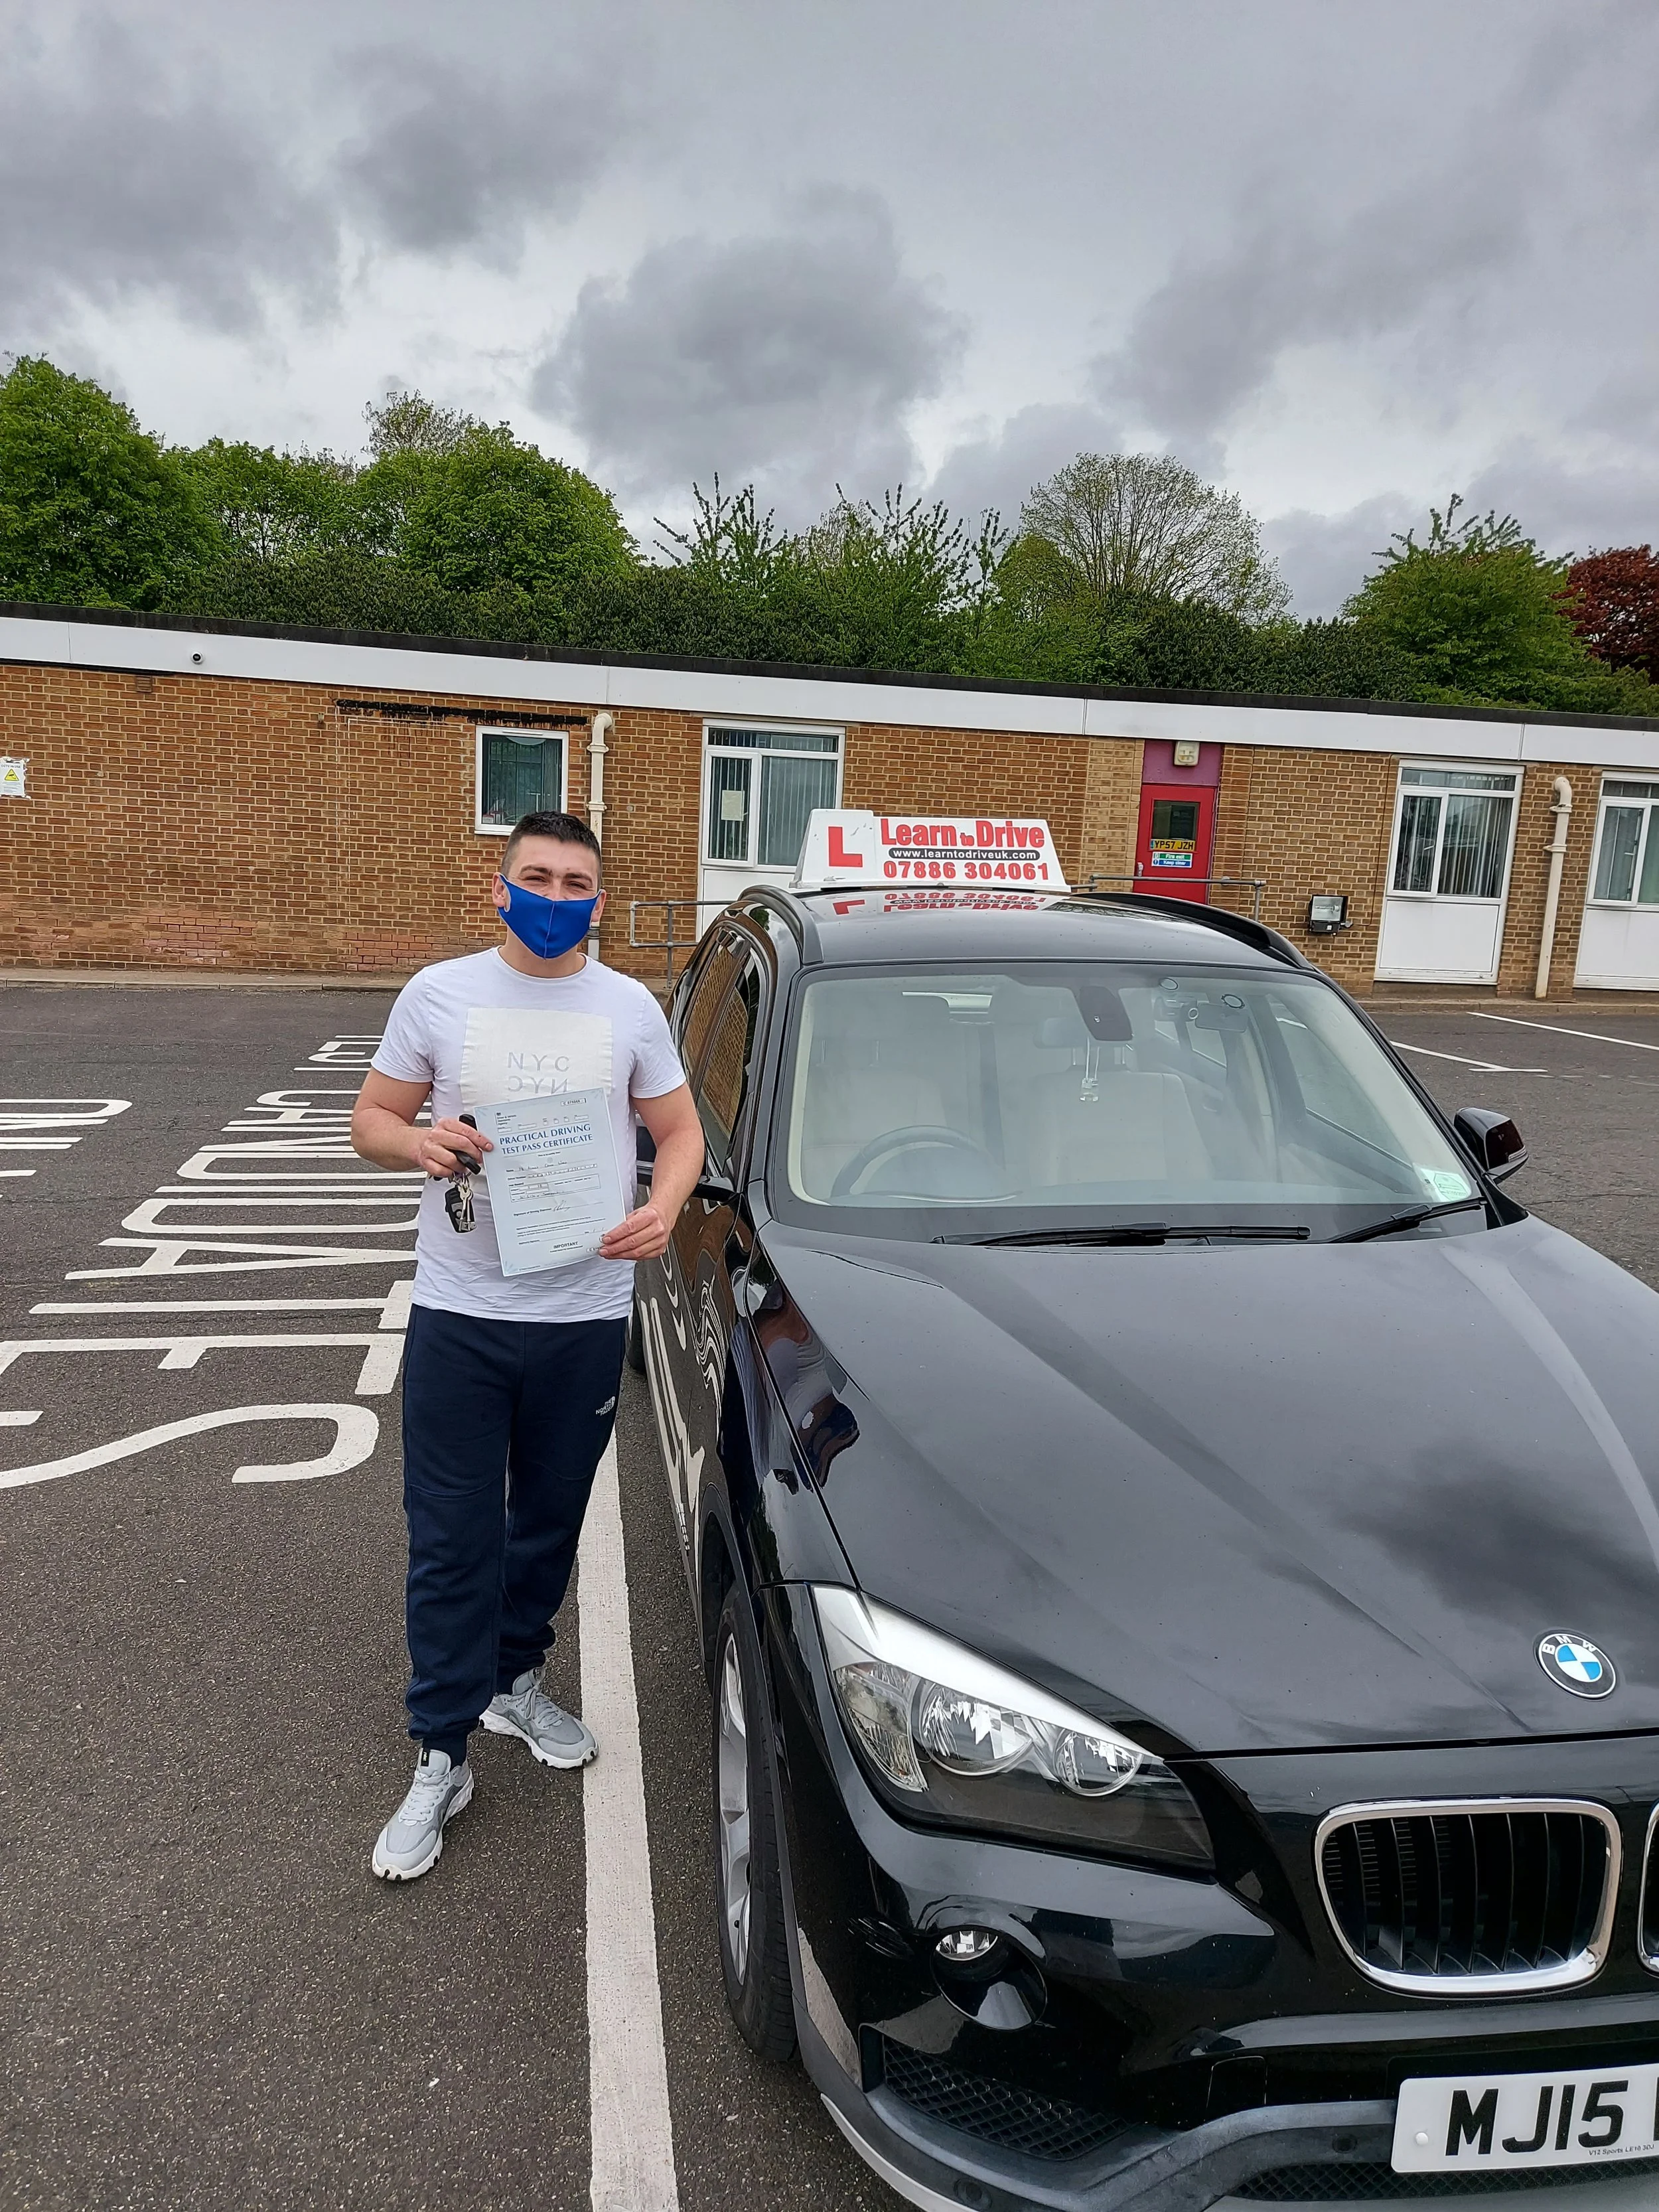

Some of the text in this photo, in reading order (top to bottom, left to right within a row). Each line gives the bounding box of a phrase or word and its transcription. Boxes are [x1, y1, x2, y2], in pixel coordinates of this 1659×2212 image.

[880, 818, 1045, 848] Learn to Drive
[828, 826, 863, 867] L
[893, 849, 1037, 859] www.learntodriveuk.com
[1155, 840, 1175, 849] YP57
[883, 860, 1048, 880] 07886 304061
[507, 1051, 569, 1072] NYC
[500, 1124, 591, 1145] PRACTICAL DRIVING
[501, 1134, 593, 1155] TEST PASS CERTIFICATE
[1542, 1635, 1597, 1655] BMW
[1445, 2079, 1629, 2156] MJ15
